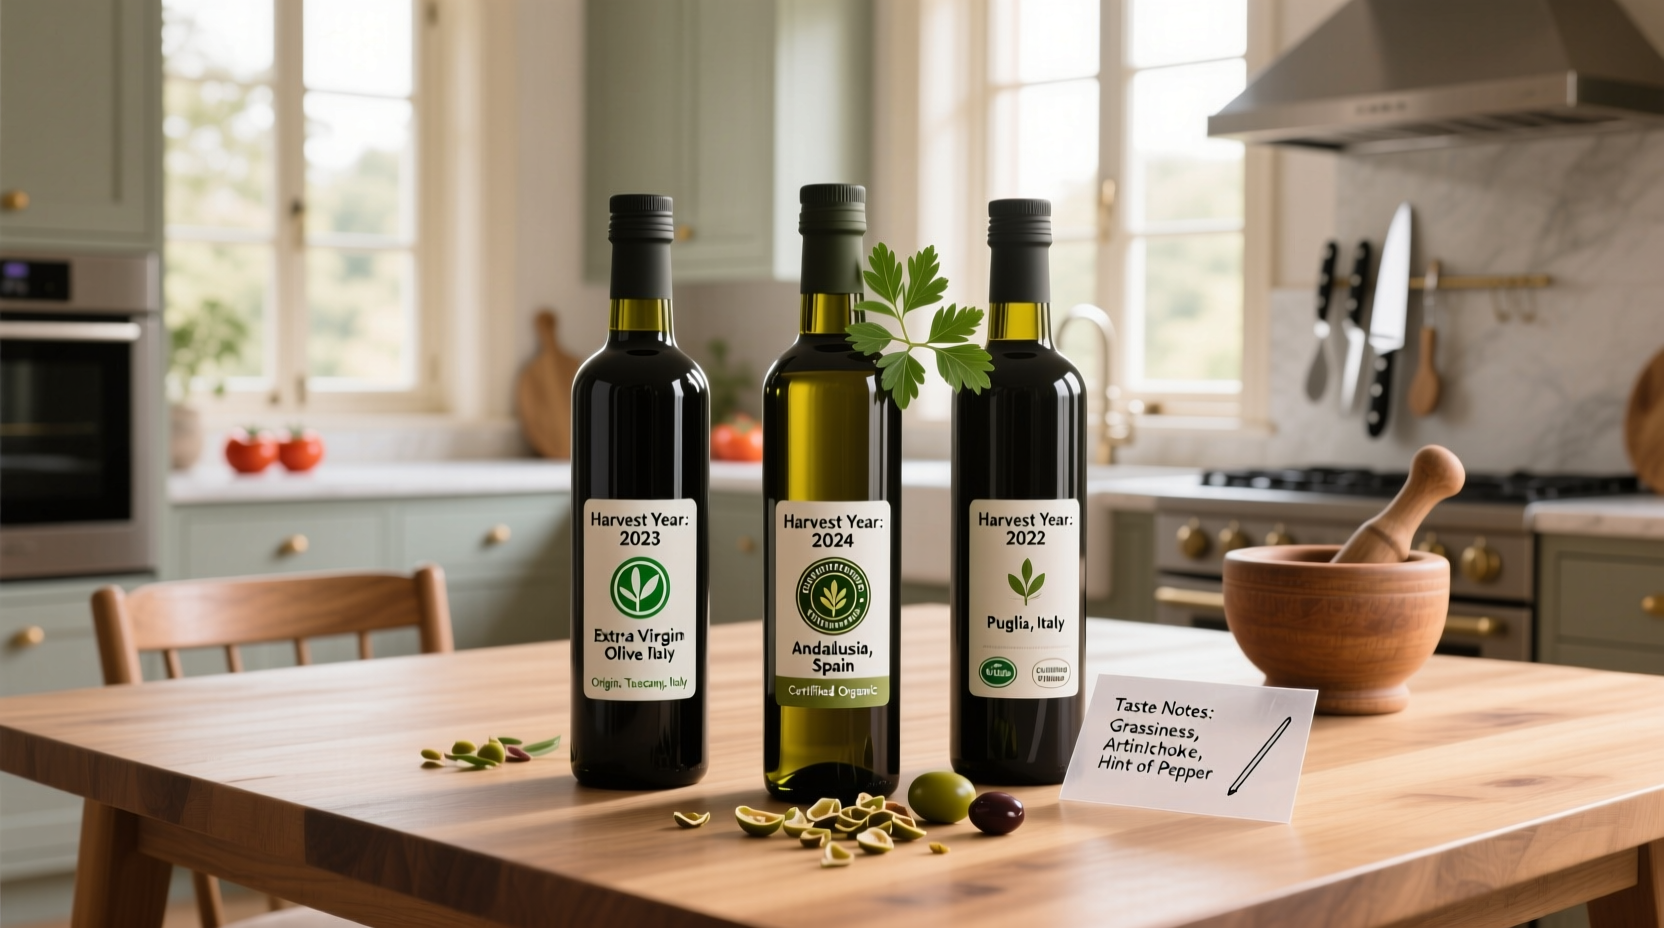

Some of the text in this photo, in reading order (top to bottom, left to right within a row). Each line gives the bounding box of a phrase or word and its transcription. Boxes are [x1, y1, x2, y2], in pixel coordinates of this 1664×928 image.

[591, 511, 689, 527] Harvest Year:
[783, 513, 884, 529] Harvest Year:
[978, 511, 1073, 527] Harvest Year:
[619, 530, 661, 546] 2023
[811, 532, 855, 548] 2024
[1005, 530, 1046, 546] 2022
[986, 615, 1065, 633] Puglia, Italy
[637, 627, 685, 646] Virgin
[604, 645, 643, 661] Olive
[791, 640, 873, 658] Andalusia,
[812, 657, 855, 676] Spain
[1115, 697, 1215, 720] Taste Notes:
[1109, 718, 1200, 743] Grassiness,
[1097, 754, 1214, 784] Hint of Pepper
